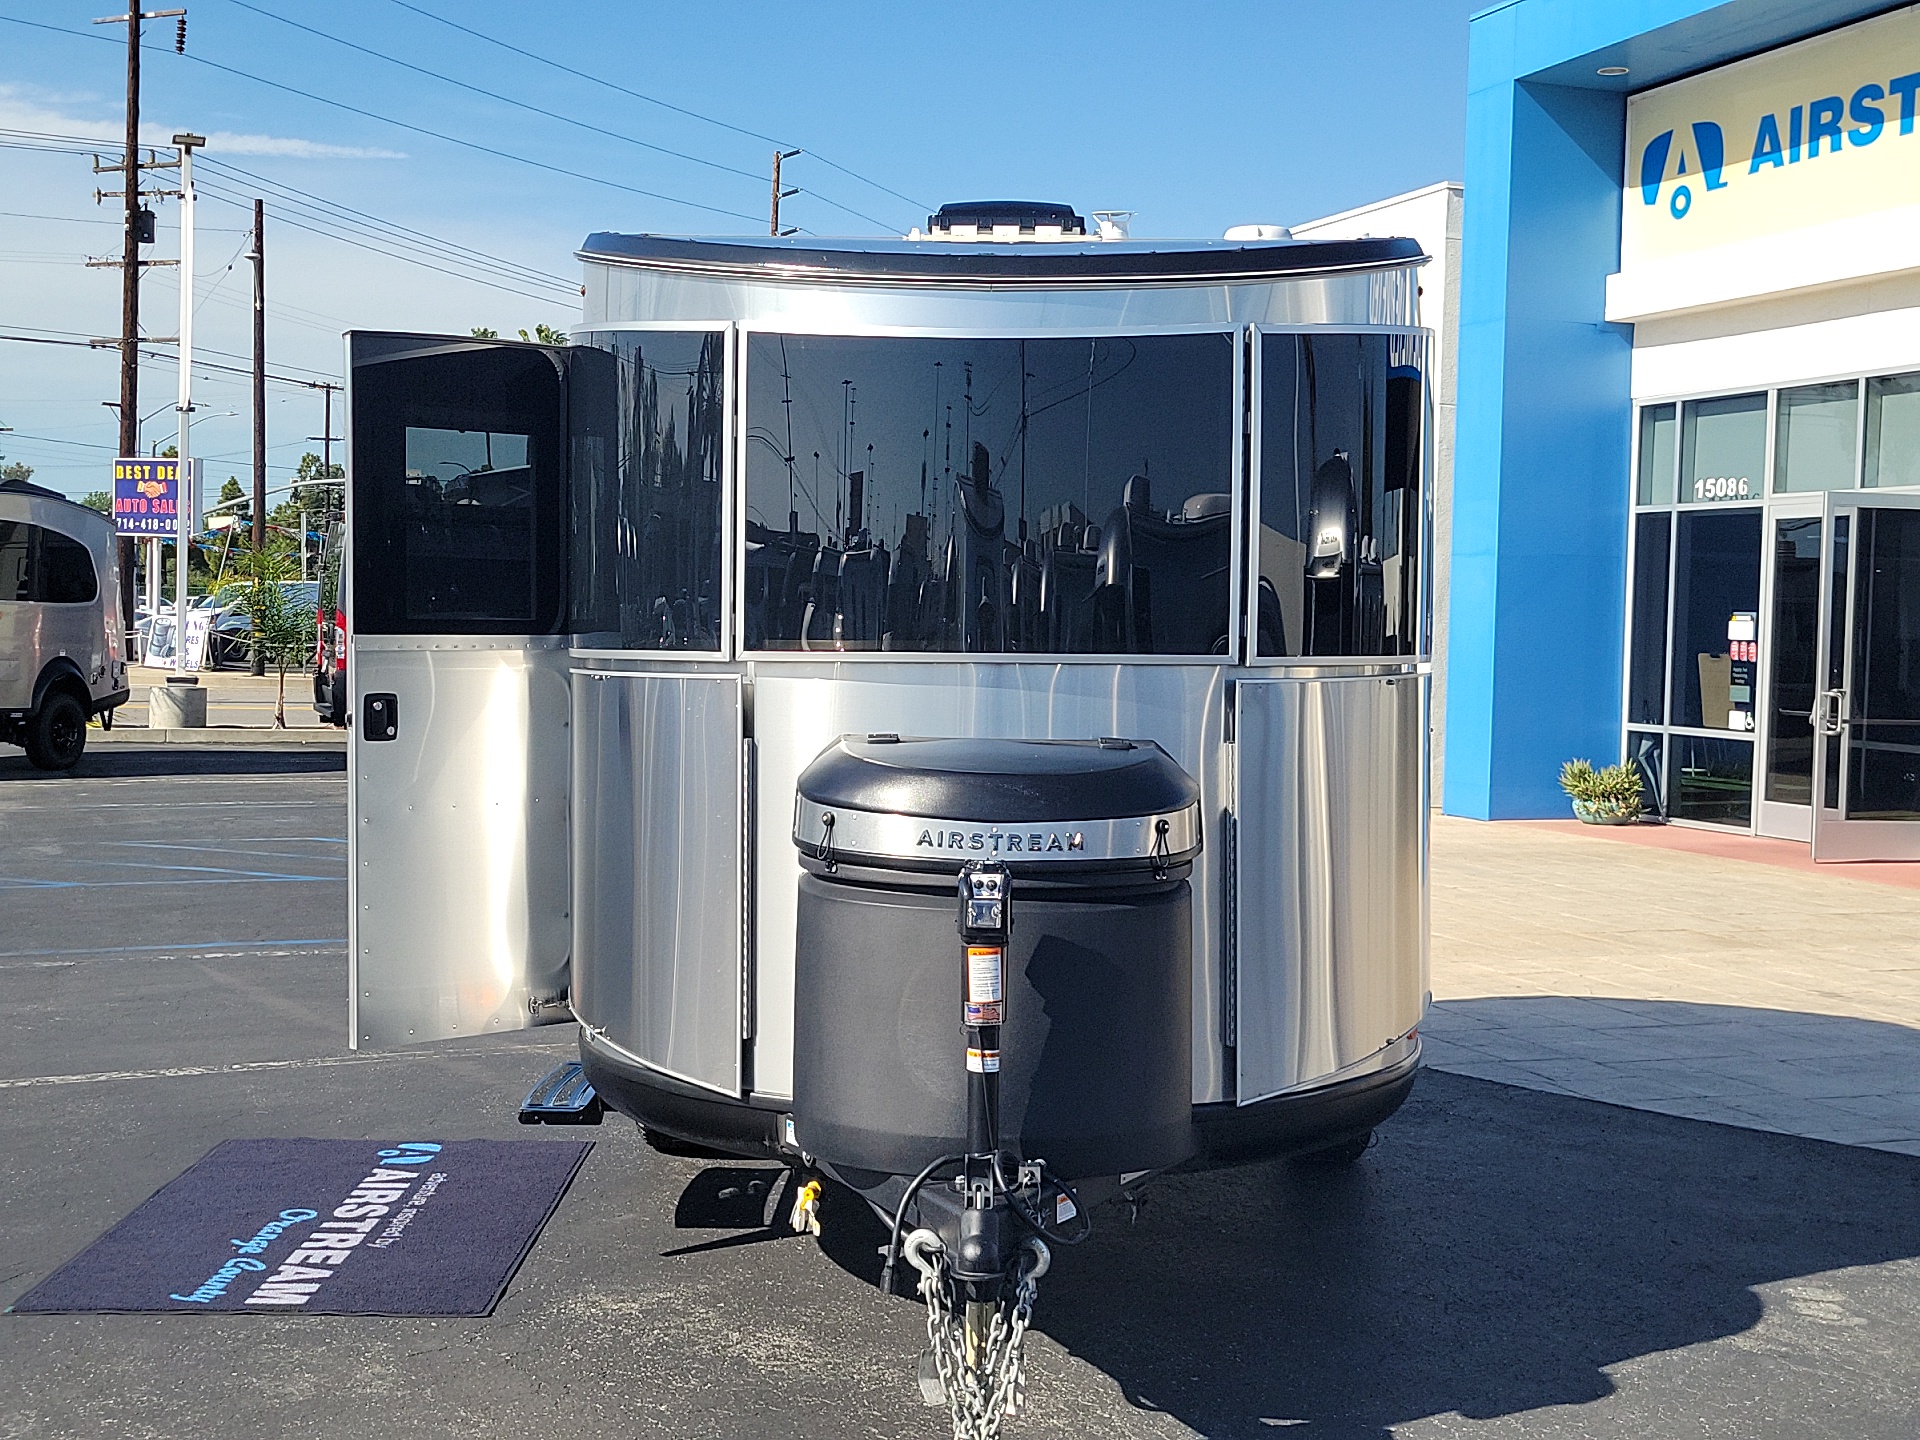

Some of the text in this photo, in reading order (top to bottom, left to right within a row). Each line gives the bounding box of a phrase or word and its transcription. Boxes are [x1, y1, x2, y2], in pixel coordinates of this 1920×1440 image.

[1748, 71, 1920, 175] AIRST
[116, 465, 190, 480] BEST DE
[1694, 477, 1748, 499] 15086
[115, 499, 190, 513] AUTO SAL
[116, 518, 190, 531] 714-418-002
[916, 829, 1084, 852] AIRSTREAM
[244, 1168, 420, 1305] AIRSTREAM
[169, 1208, 318, 1304] Orange County
